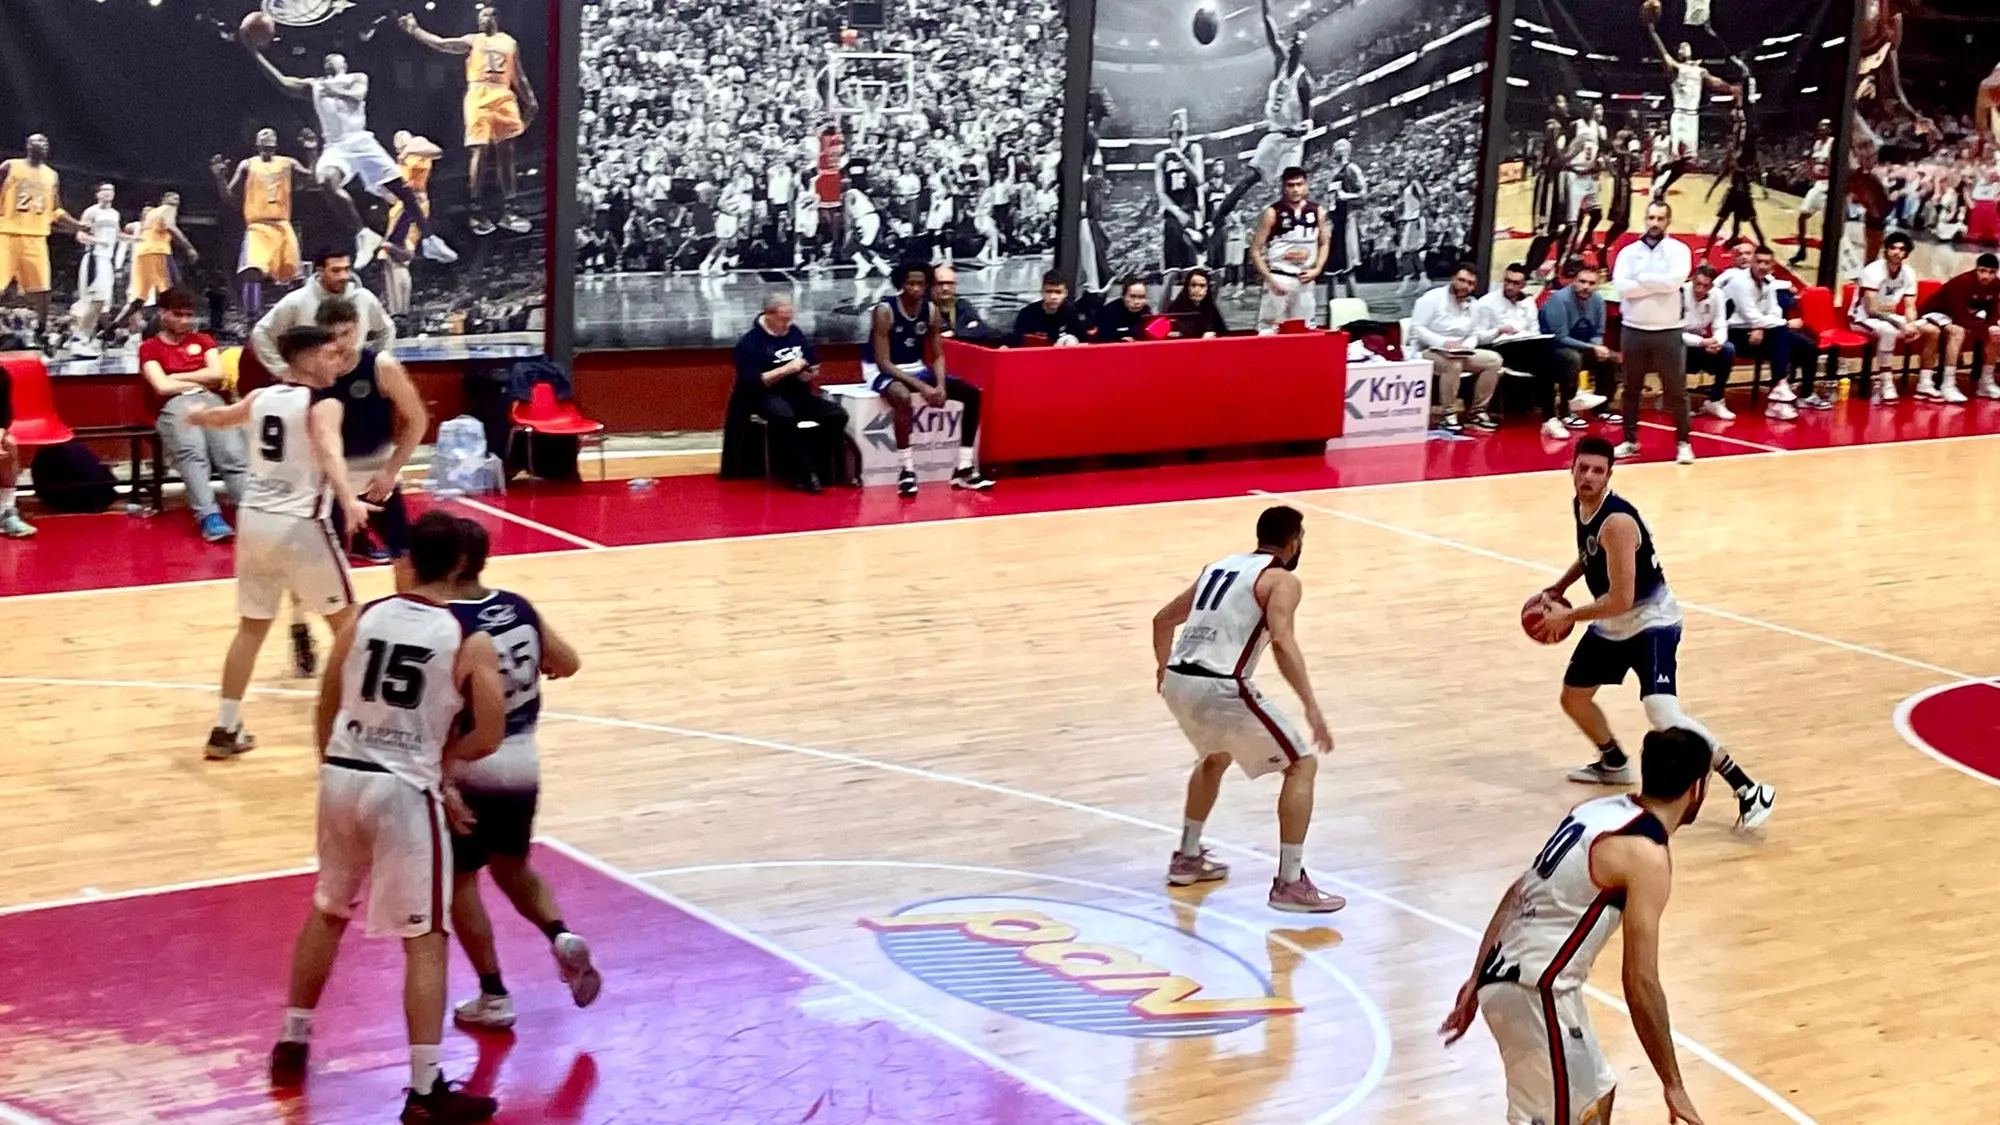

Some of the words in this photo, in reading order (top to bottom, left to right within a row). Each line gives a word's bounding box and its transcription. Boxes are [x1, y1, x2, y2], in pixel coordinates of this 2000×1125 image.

[1369, 374, 1426, 405] Kriya
[260, 415, 286, 463] 9
[910, 405, 962, 437] Kriy
[1196, 569, 1240, 611] 11
[361, 638, 435, 710] 15
